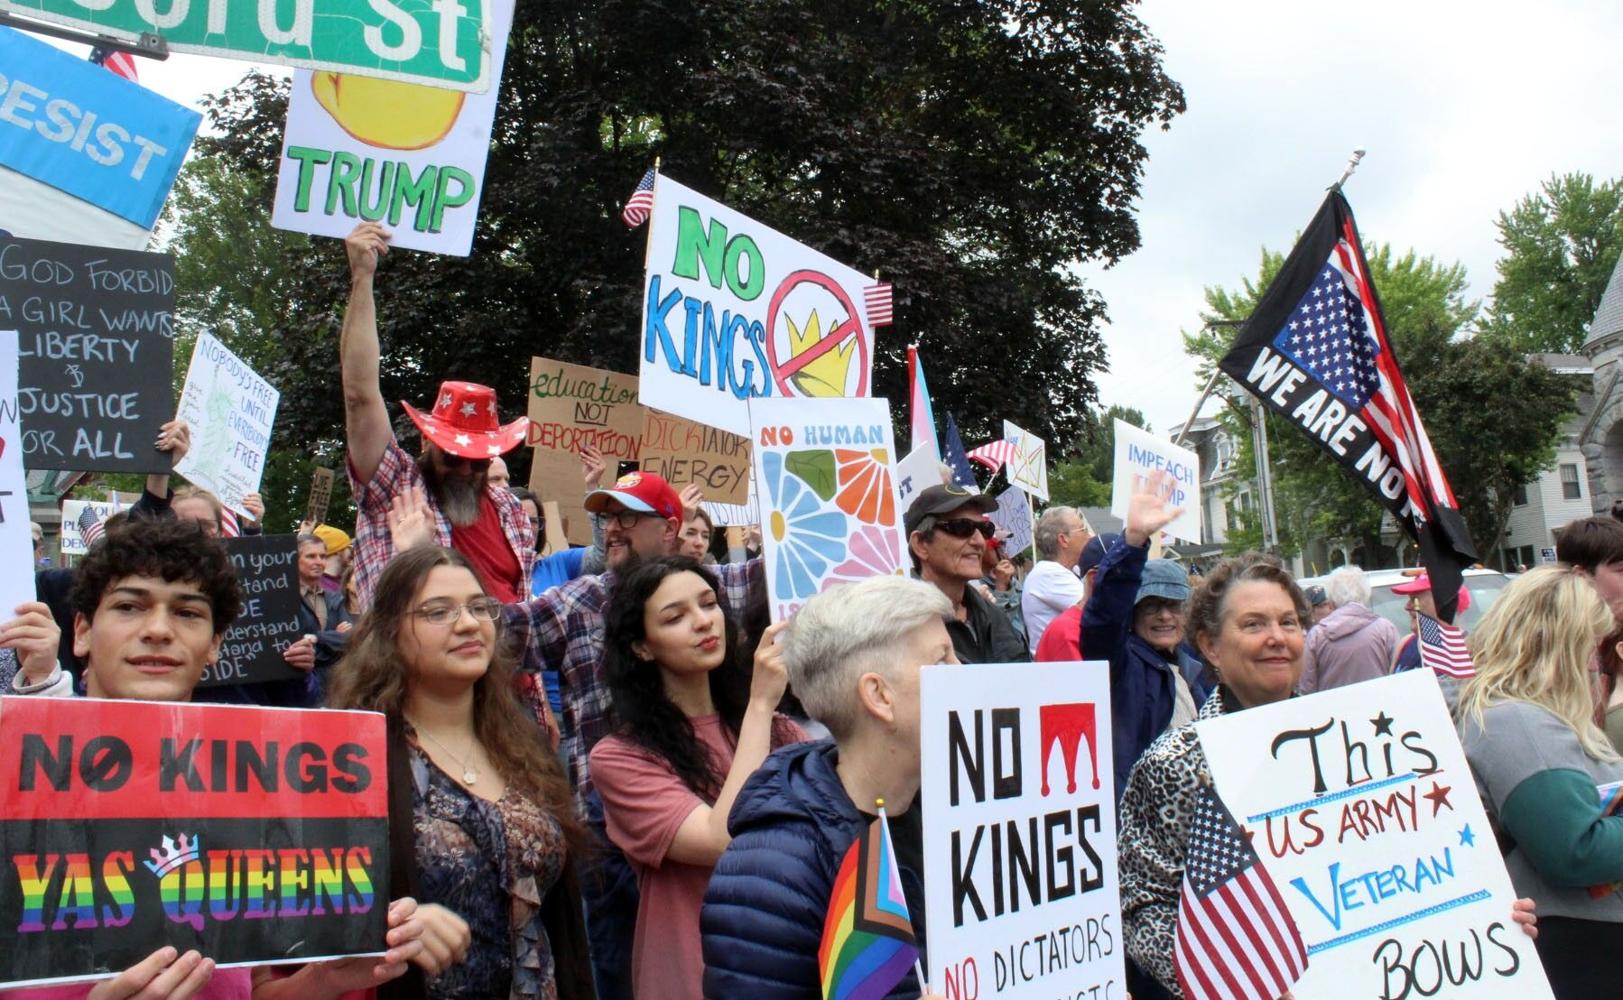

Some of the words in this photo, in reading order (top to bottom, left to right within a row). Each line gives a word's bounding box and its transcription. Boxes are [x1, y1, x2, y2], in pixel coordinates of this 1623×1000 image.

[364, 0, 468, 73] St
[0, 73, 168, 181] ESIST
[287, 145, 477, 234] TRUMP
[0, 244, 75, 285] GOD
[84, 259, 175, 296] FORBID
[671, 204, 766, 302] NO
[22, 296, 92, 329] GIRL
[99, 308, 174, 338] WANTS
[645, 274, 773, 400] KINGS
[18, 386, 141, 420] JUSTICE
[240, 395, 270, 428] UNTIL
[251, 378, 274, 410] FREE
[530, 368, 640, 405] education
[574, 401, 615, 424] NOT
[1246, 346, 1307, 407] WE
[1292, 388, 1367, 457] ARE
[72, 427, 134, 460] ALL
[234, 440, 261, 473] FREE
[527, 420, 643, 460] DEPORTATION
[760, 425, 794, 447] NO
[804, 424, 884, 445] HUMAN
[642, 456, 747, 495] ENERGY
[1128, 443, 1194, 486] IMPEACH
[240, 573, 288, 594] tand
[250, 550, 297, 575] your
[221, 616, 300, 641] derstand
[159, 737, 372, 794] KINGS
[949, 707, 1022, 807] NO
[1270, 717, 1440, 797] This
[1265, 809, 1325, 859] US
[1338, 784, 1422, 844] ARMY
[12, 850, 136, 933] YAS
[159, 846, 375, 932] QUEENS
[951, 804, 1104, 928] KINGS
[1289, 847, 1455, 931] VETERAN
[945, 956, 979, 1000] NO
[994, 914, 1113, 993] DICTATORS
[1373, 921, 1520, 1000] BOWS
